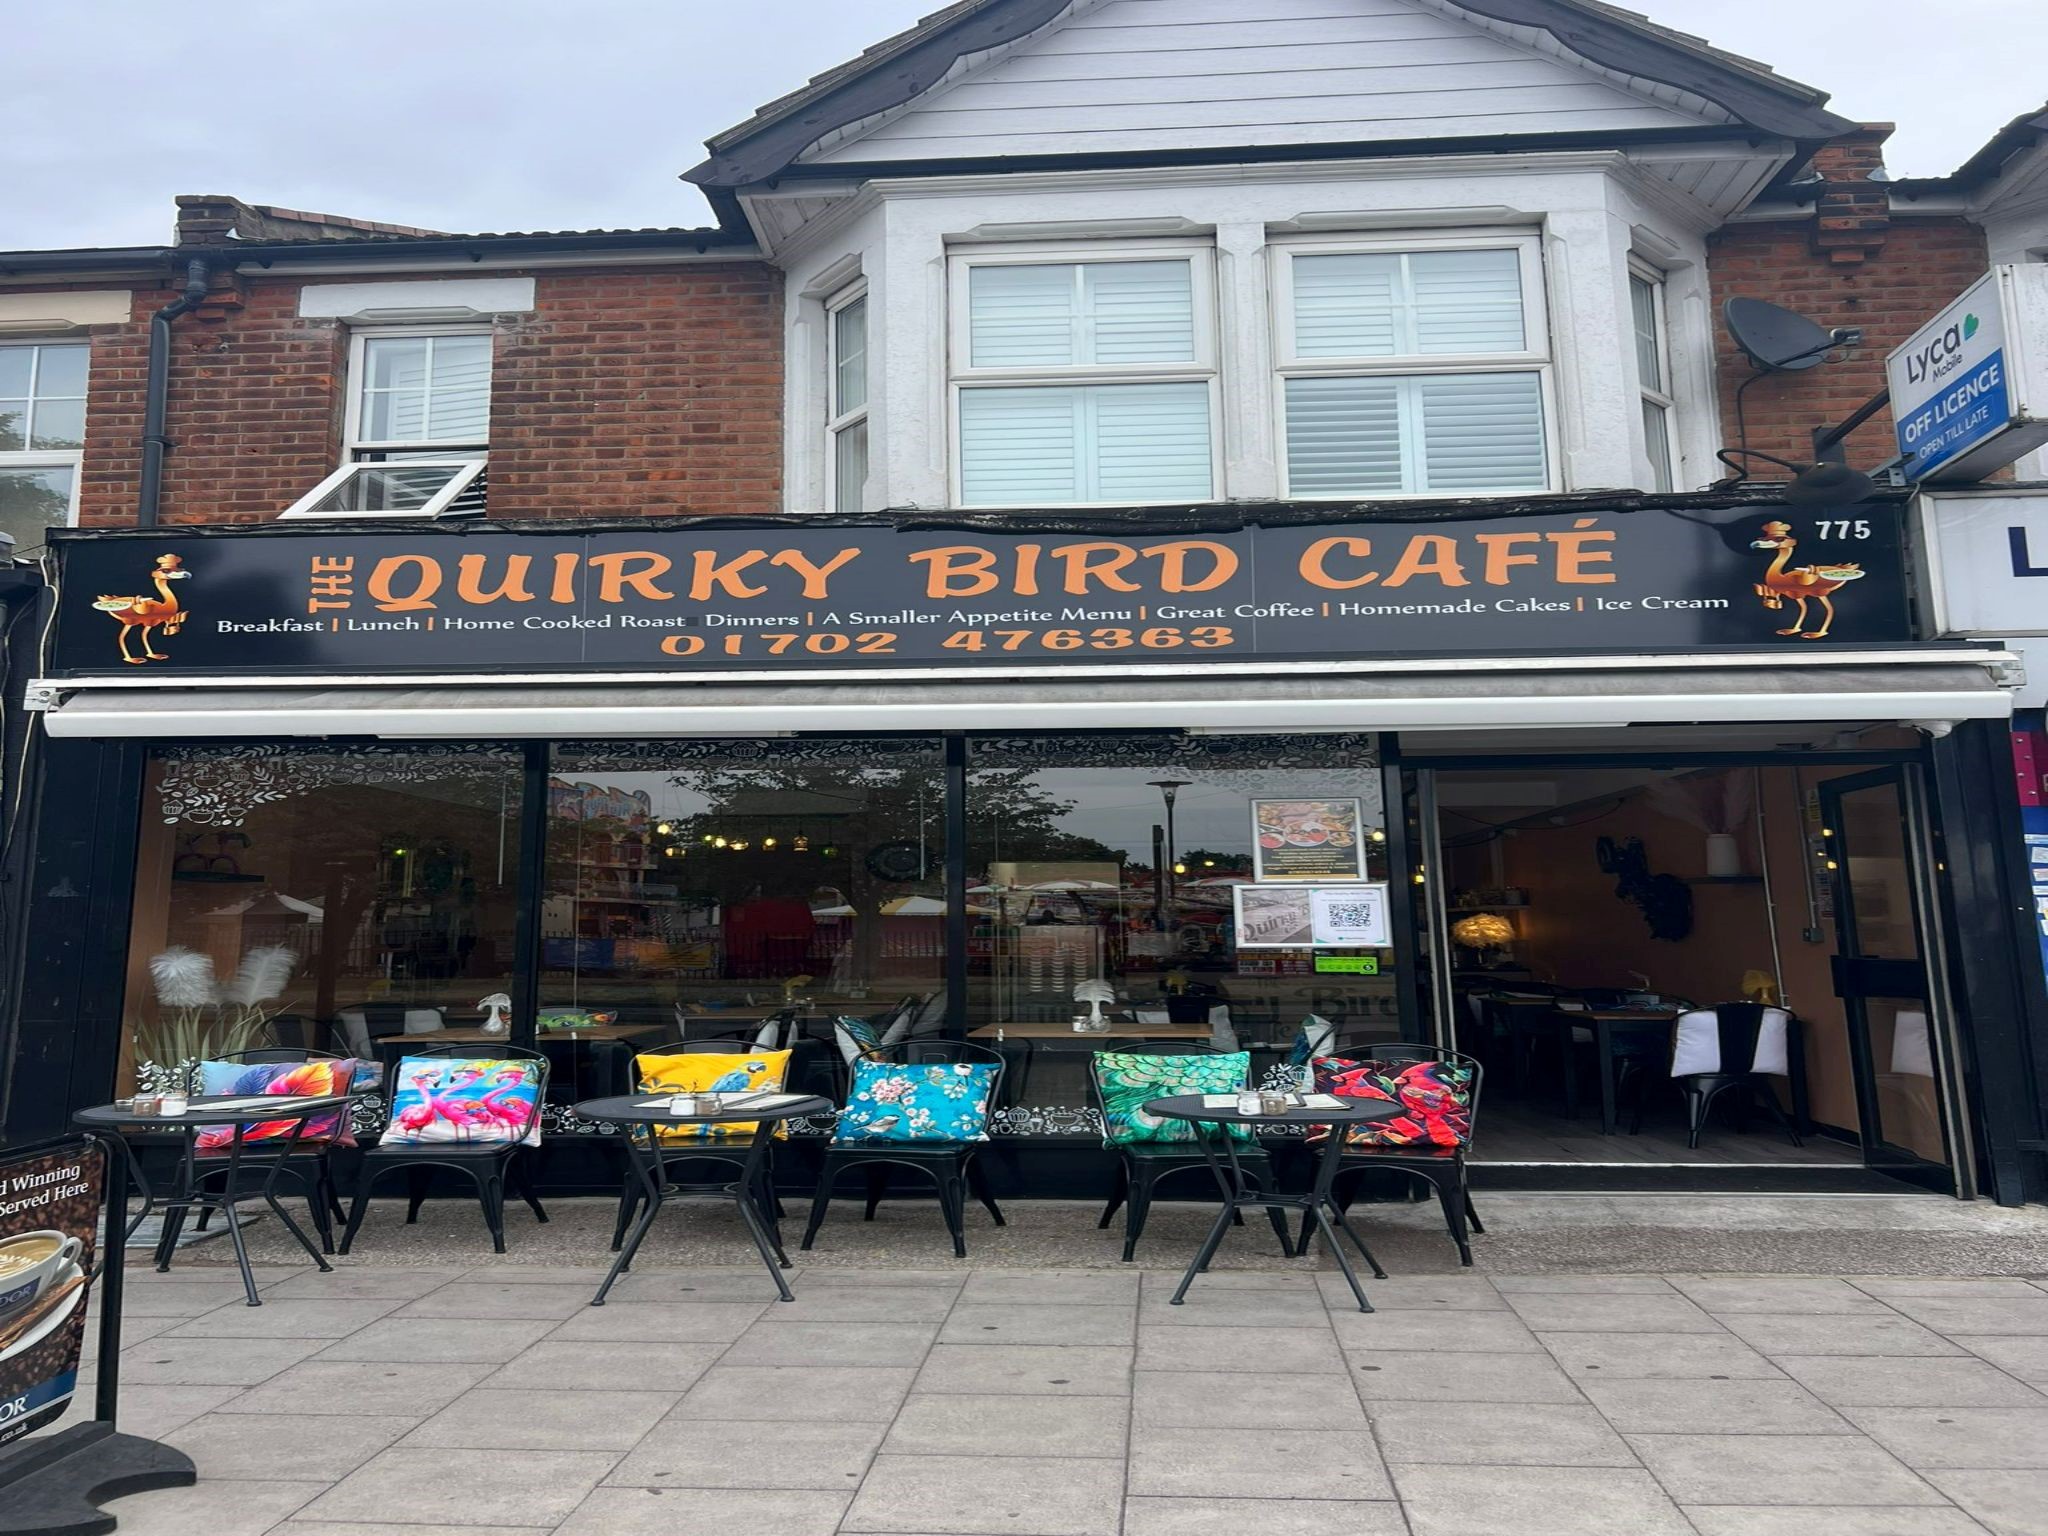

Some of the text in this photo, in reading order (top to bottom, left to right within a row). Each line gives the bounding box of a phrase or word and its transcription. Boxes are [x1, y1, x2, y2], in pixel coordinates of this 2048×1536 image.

[1906, 323, 1961, 384] Lyca
[1933, 353, 1963, 382] Mobile
[1905, 363, 2000, 443] OFF LICENCE
[1919, 405, 1989, 459] OPEN TILL LATE
[1815, 520, 1872, 541] 775
[308, 518, 1616, 614] THE QUIRKY BIRD CAFÉ
[217, 596, 1729, 633] Breakfast Lunch Home Cooked Roast Dinners A Smaller Appetite Menu Great Coffee Homemade Cakes Ice Cream
[659, 626, 1235, 656] 01702 476363
[12, 1165, 81, 1192] Winning
[0, 1182, 89, 1217] Served Here
